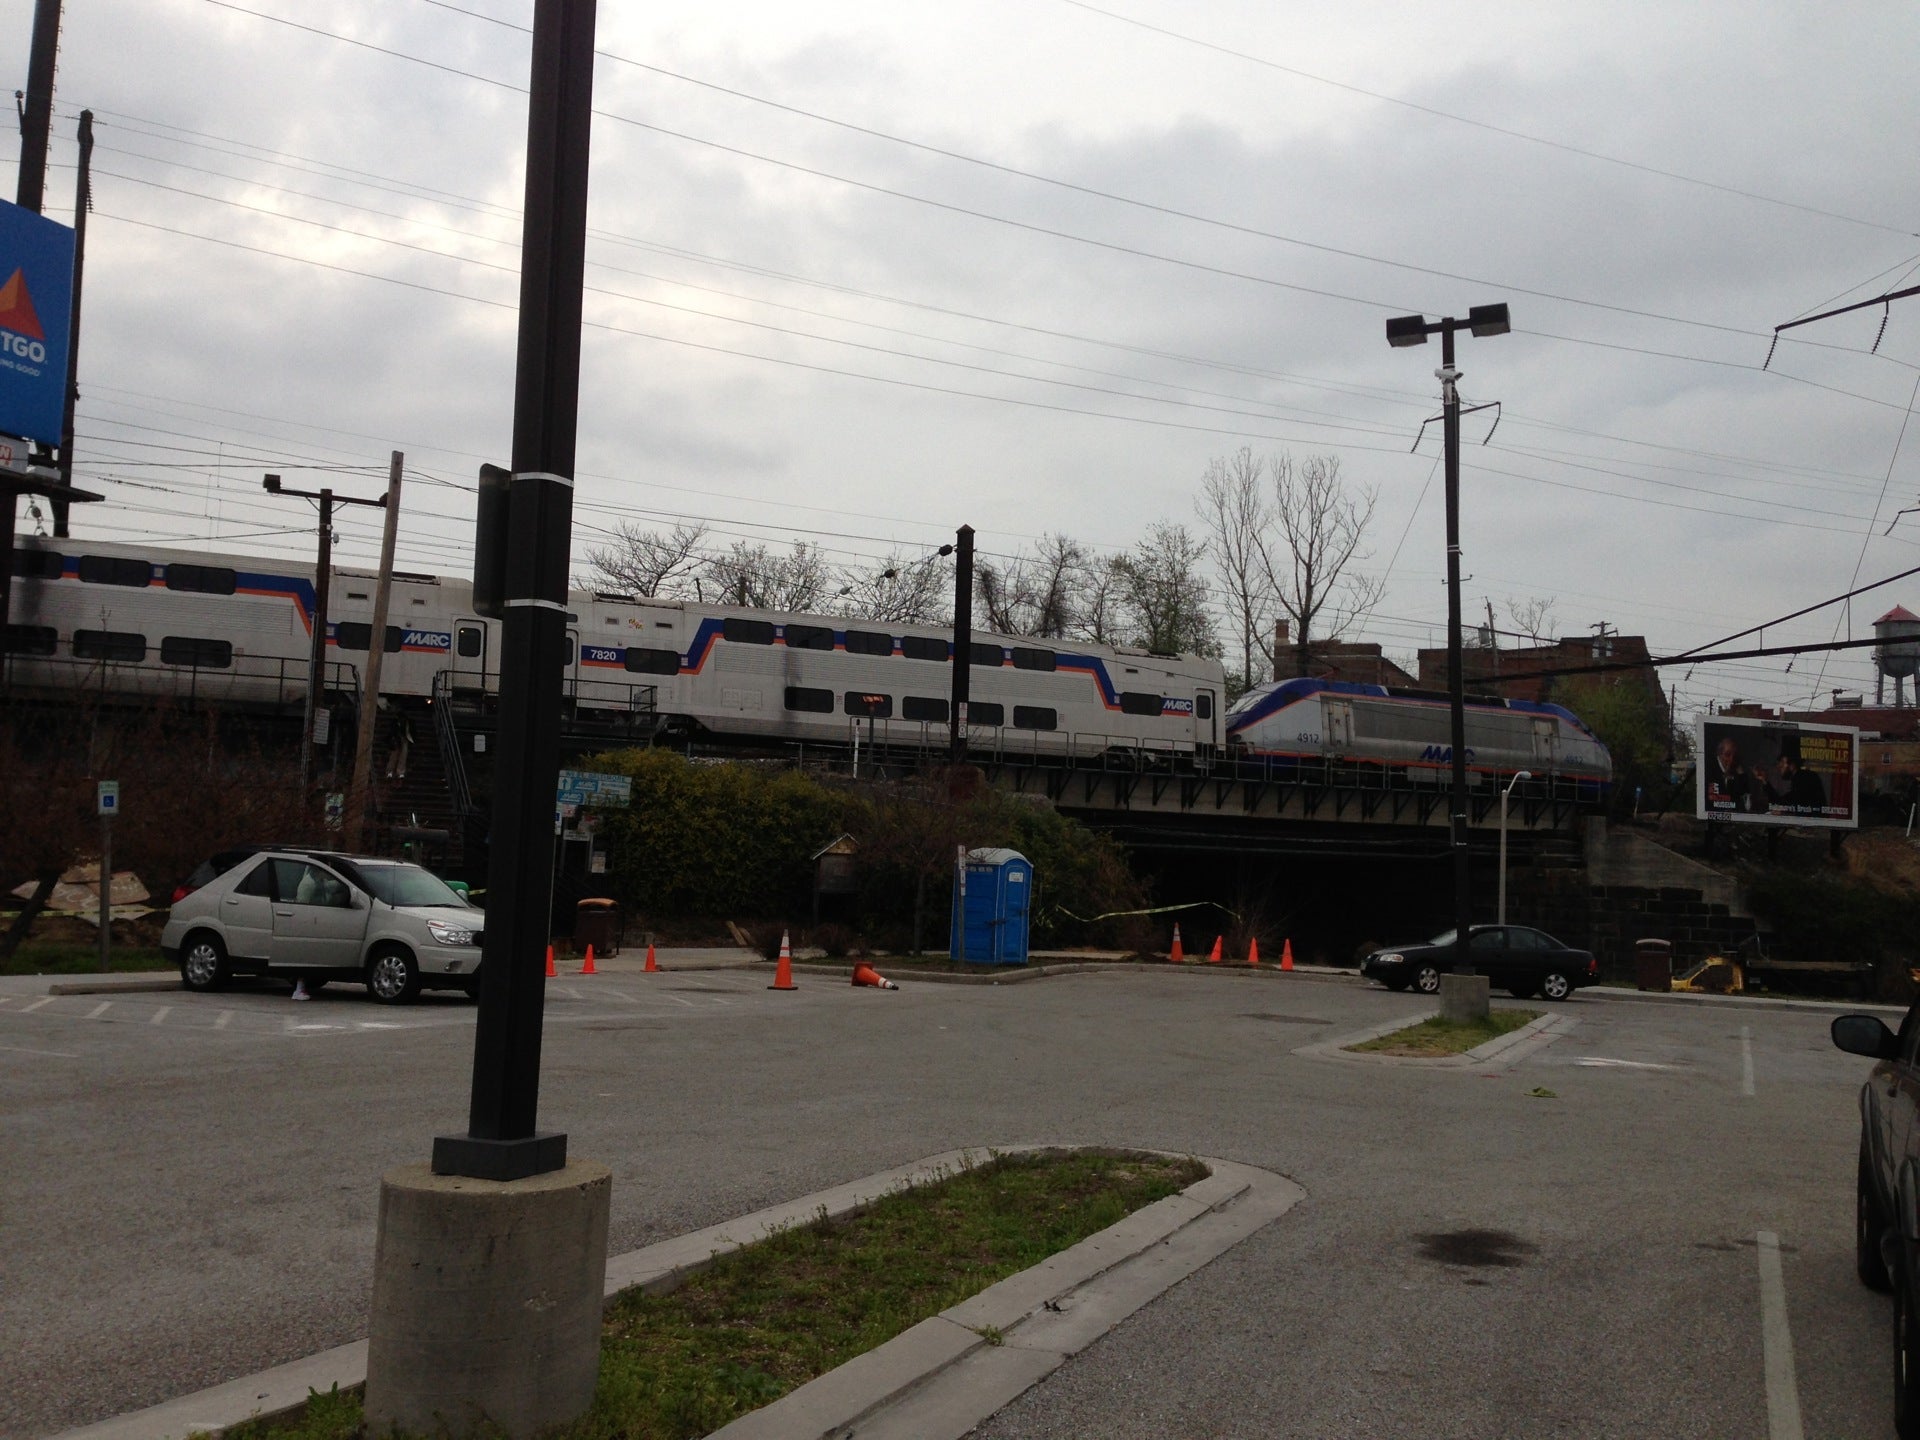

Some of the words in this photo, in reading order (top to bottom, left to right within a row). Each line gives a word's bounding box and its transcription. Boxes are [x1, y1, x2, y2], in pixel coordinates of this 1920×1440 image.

[403, 632, 450, 647] MARC
[590, 649, 617, 661] 7820
[1162, 699, 1192, 711] MARC
[1297, 732, 1319, 744] 4912
[1420, 745, 1475, 762] MAC
